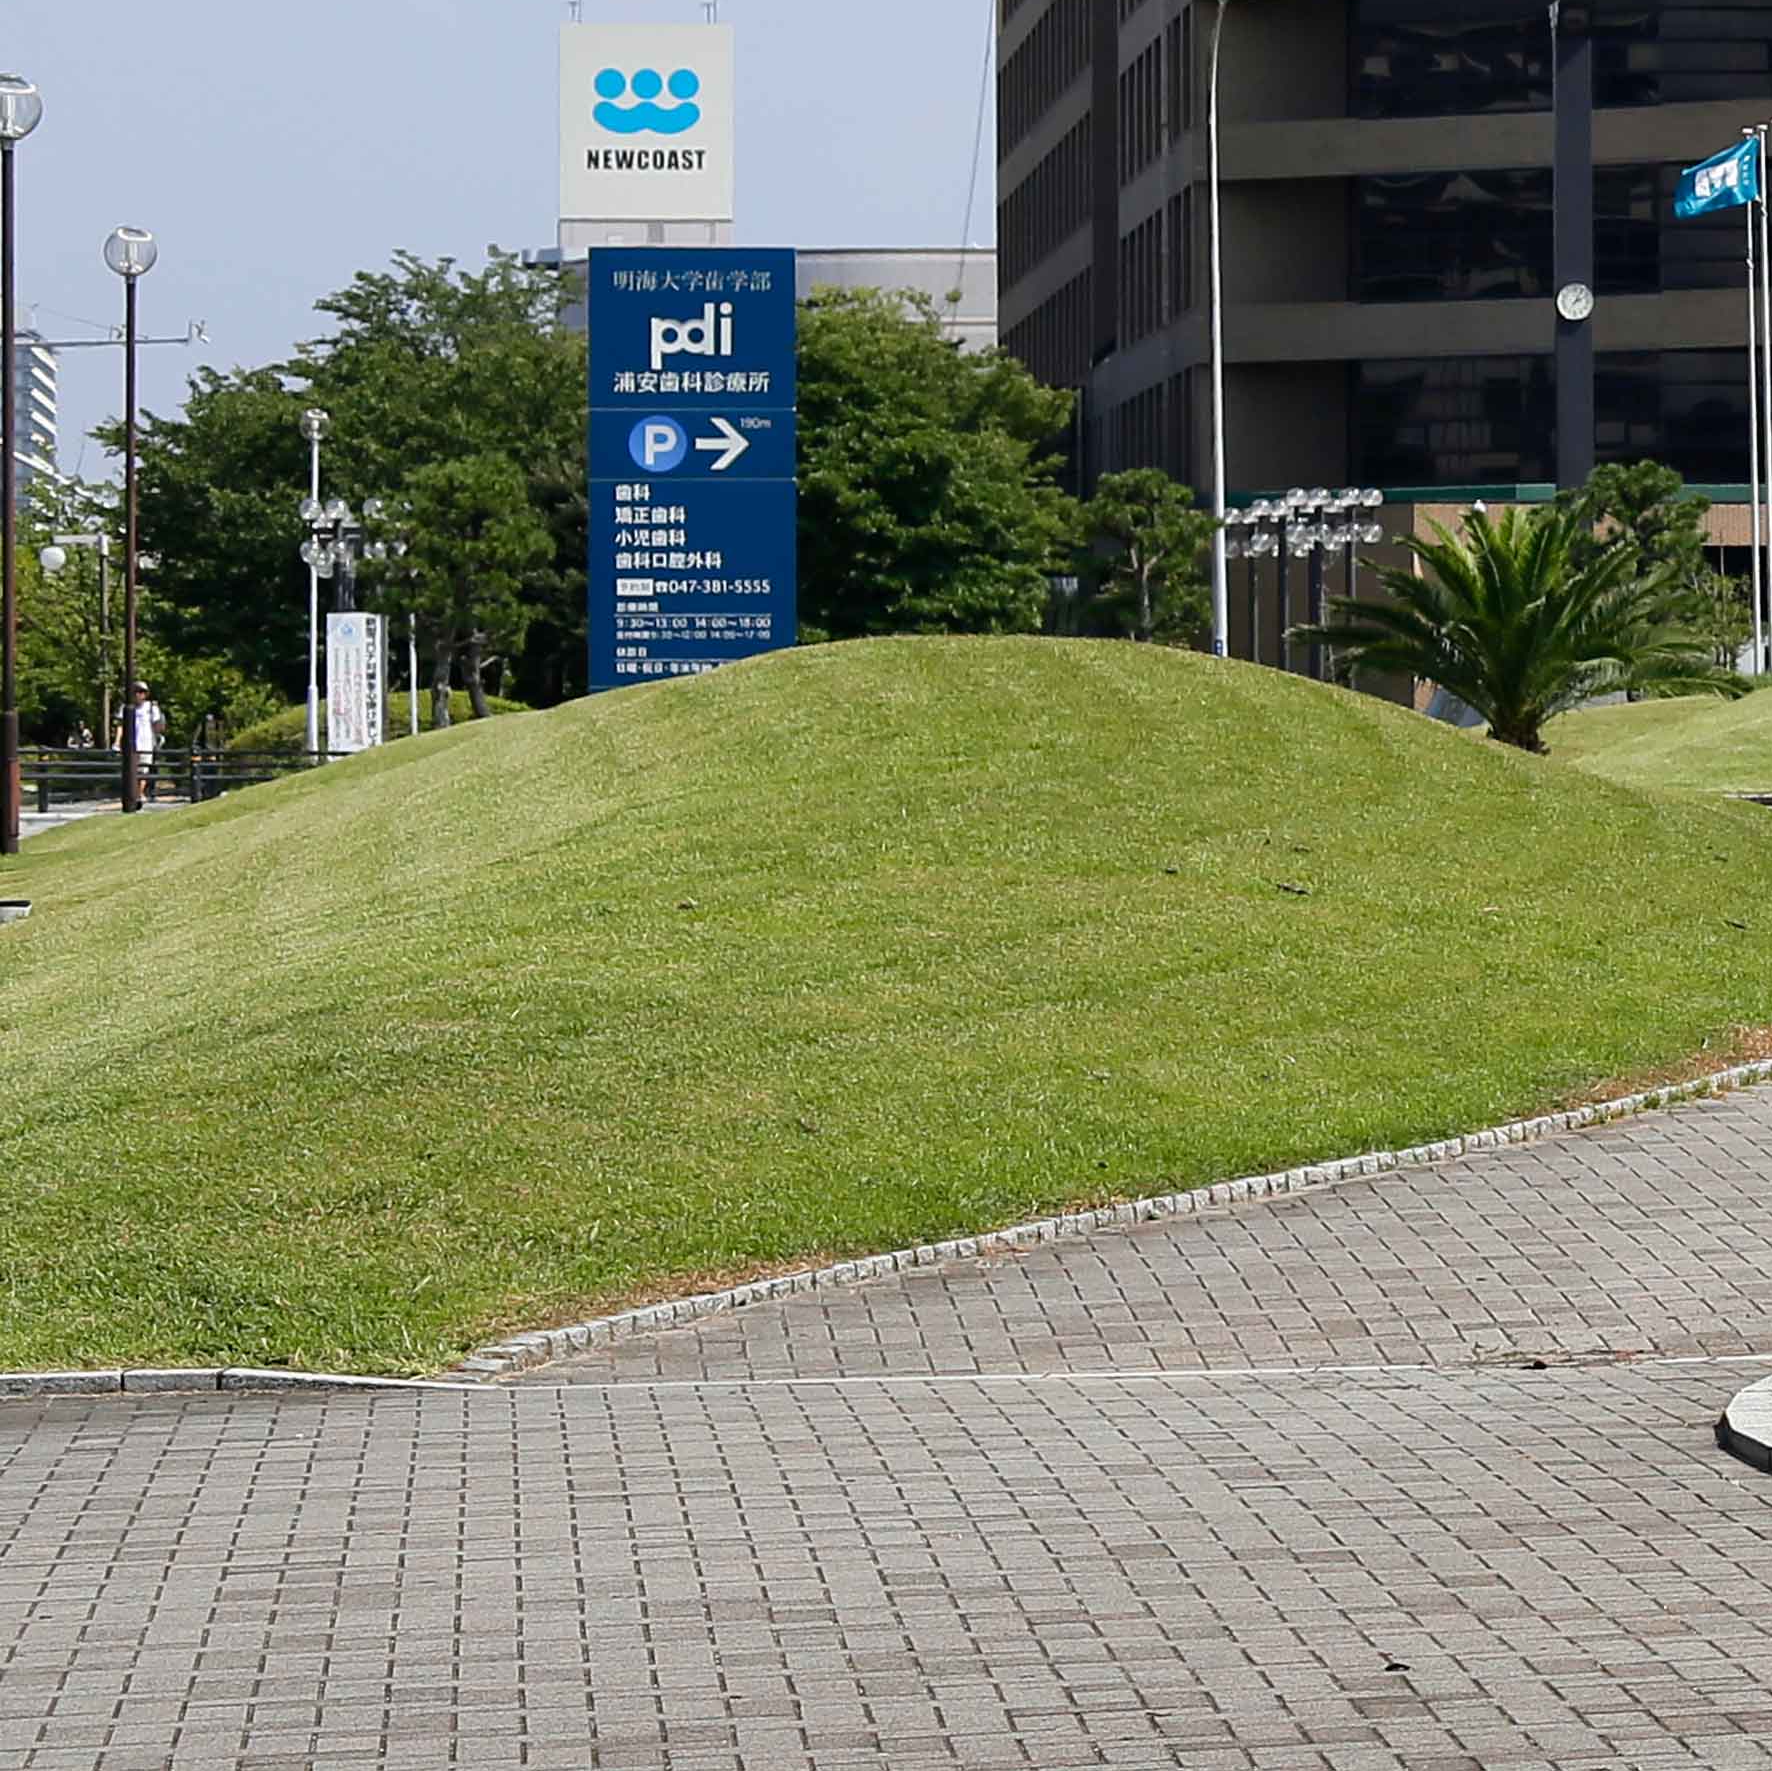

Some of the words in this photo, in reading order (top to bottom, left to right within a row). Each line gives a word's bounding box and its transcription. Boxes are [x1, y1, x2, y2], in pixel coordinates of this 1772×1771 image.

[586, 149, 706, 170] NEWCOAST
[612, 269, 772, 292] 明海大学歯学部
[650, 301, 733, 370] pdi
[613, 371, 770, 394] 浦安歯科診療所
[644, 425, 678, 466] P
[615, 483, 651, 502] 歯科
[615, 505, 687, 525] 矯正歯科
[615, 529, 687, 547] 小児歯科
[615, 551, 722, 570] 歯科口腔外科
[668, 579, 771, 594] 047-381-5555
